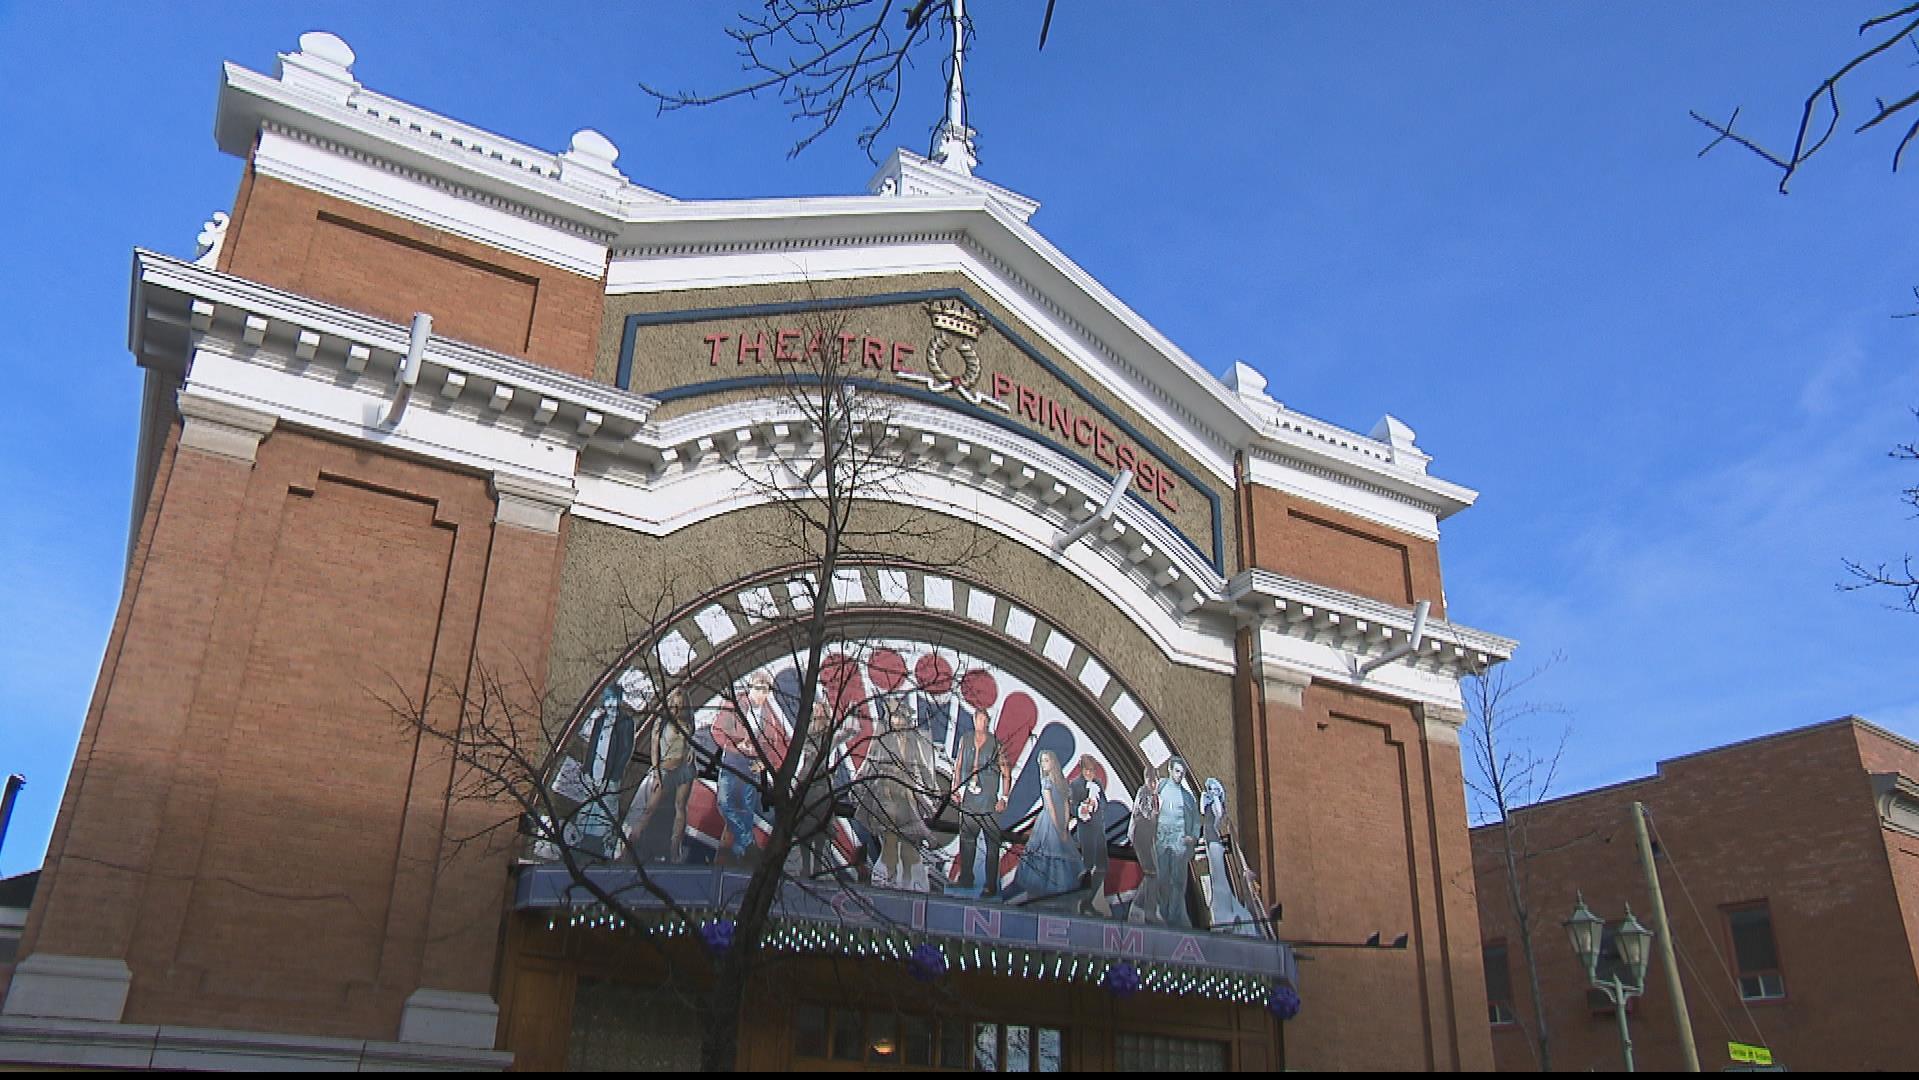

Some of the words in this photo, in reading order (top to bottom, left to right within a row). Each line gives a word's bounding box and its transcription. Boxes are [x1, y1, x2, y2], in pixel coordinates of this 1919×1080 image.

[703, 328, 916, 373] THEATRE
[992, 371, 1179, 512] PRINCESSE
[830, 892, 1207, 963] CINEMA
